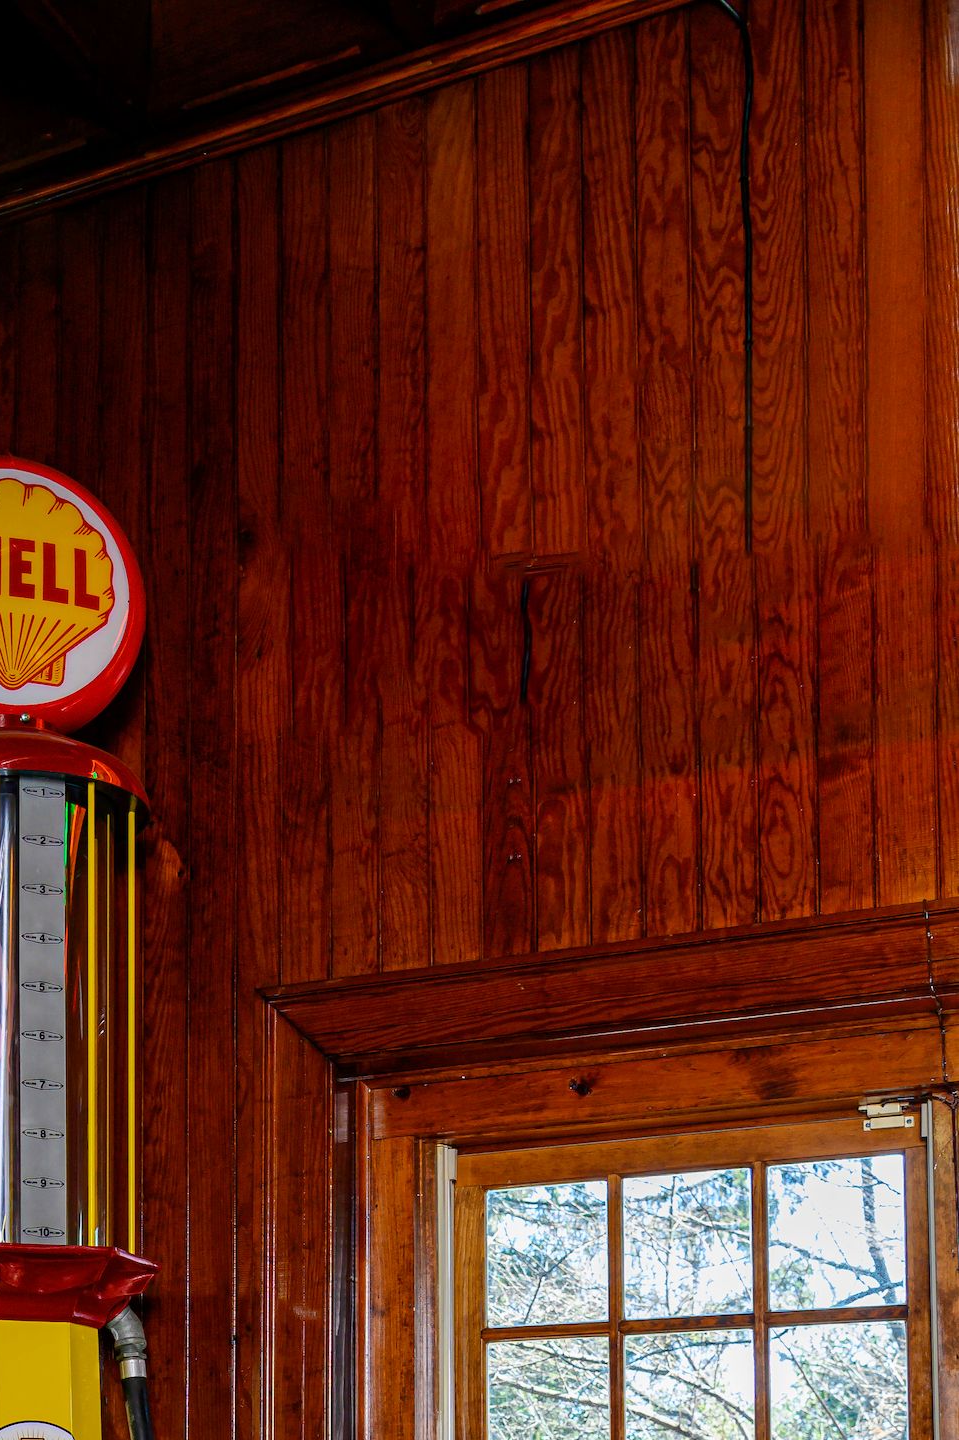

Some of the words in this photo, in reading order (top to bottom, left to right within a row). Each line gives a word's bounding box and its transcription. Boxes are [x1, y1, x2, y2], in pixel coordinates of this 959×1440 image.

[41, 788, 46, 796] 1
[40, 836, 46, 844] 2
[40, 886, 46, 894] 3
[39, 934, 46, 942] 4
[39, 982, 45, 991] 5
[39, 1031, 45, 1040] 6
[40, 1080, 46, 1088] 7
[40, 1129, 46, 1138] 8
[40, 1178, 46, 1188] 9
[38, 1228, 50, 1236] 10
